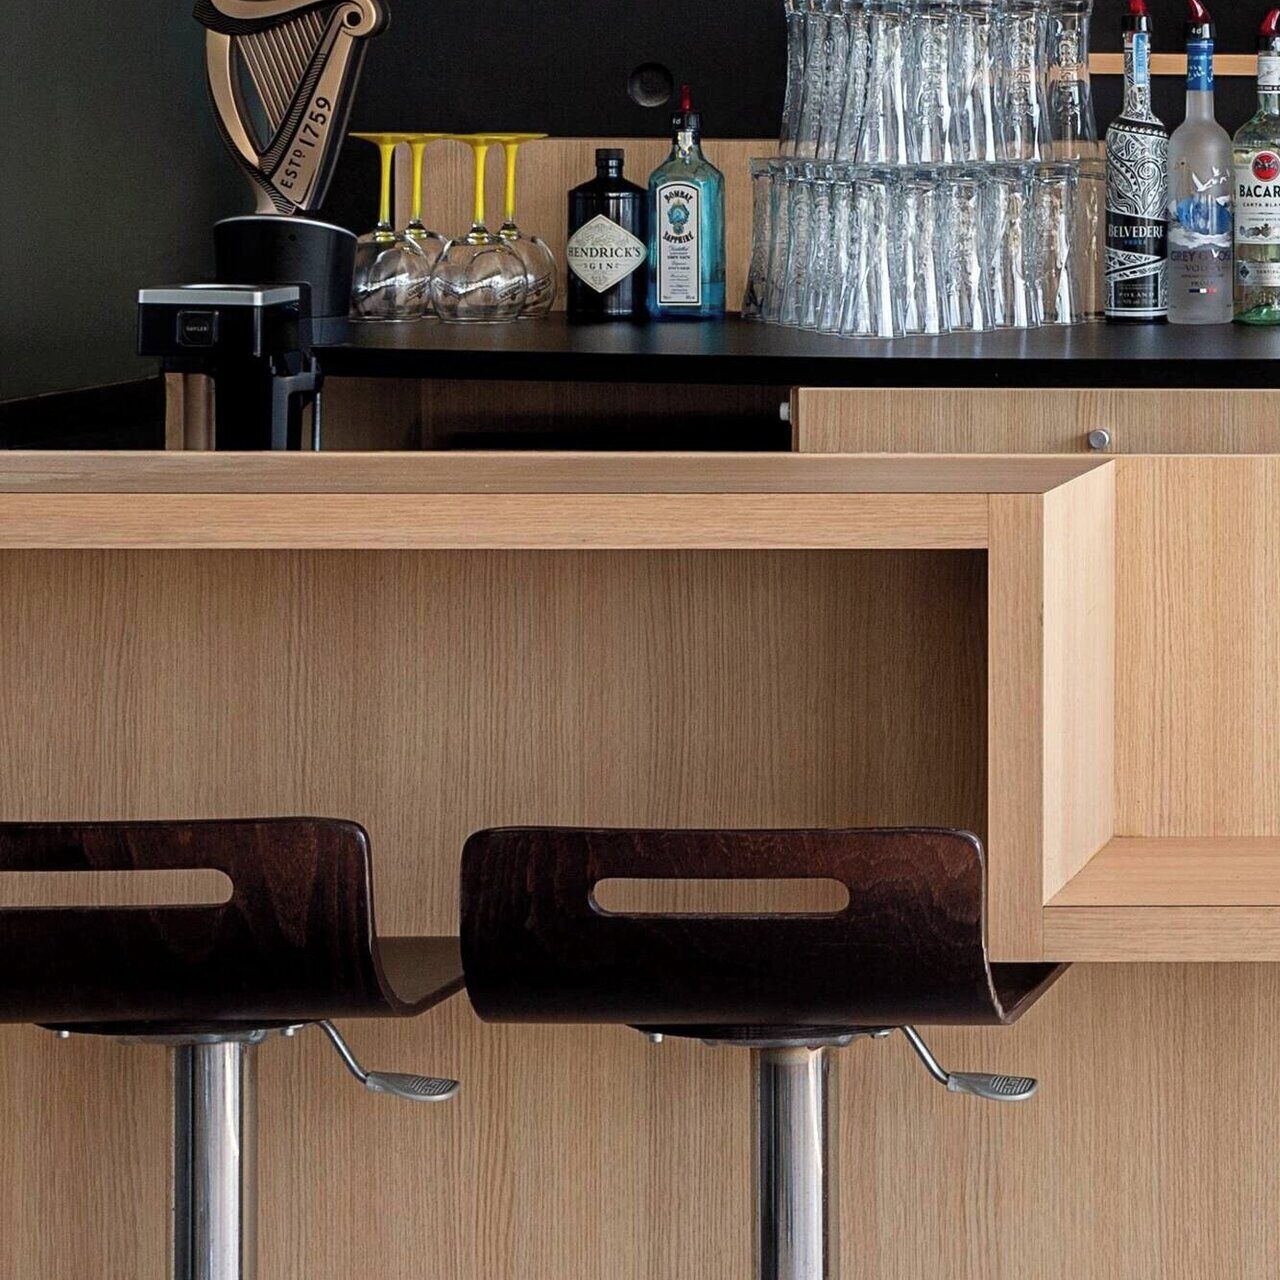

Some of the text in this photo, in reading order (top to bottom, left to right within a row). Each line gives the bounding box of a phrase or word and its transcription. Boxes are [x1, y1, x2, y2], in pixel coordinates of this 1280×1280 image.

[299, 96, 332, 149] 1759
[664, 190, 694, 203] BOMBAY
[1108, 224, 1164, 239] BELVEDERE
[662, 232, 695, 244] SAPPHIRE
[568, 246, 641, 258] HENDRICK'S
[589, 262, 614, 270] GIN
